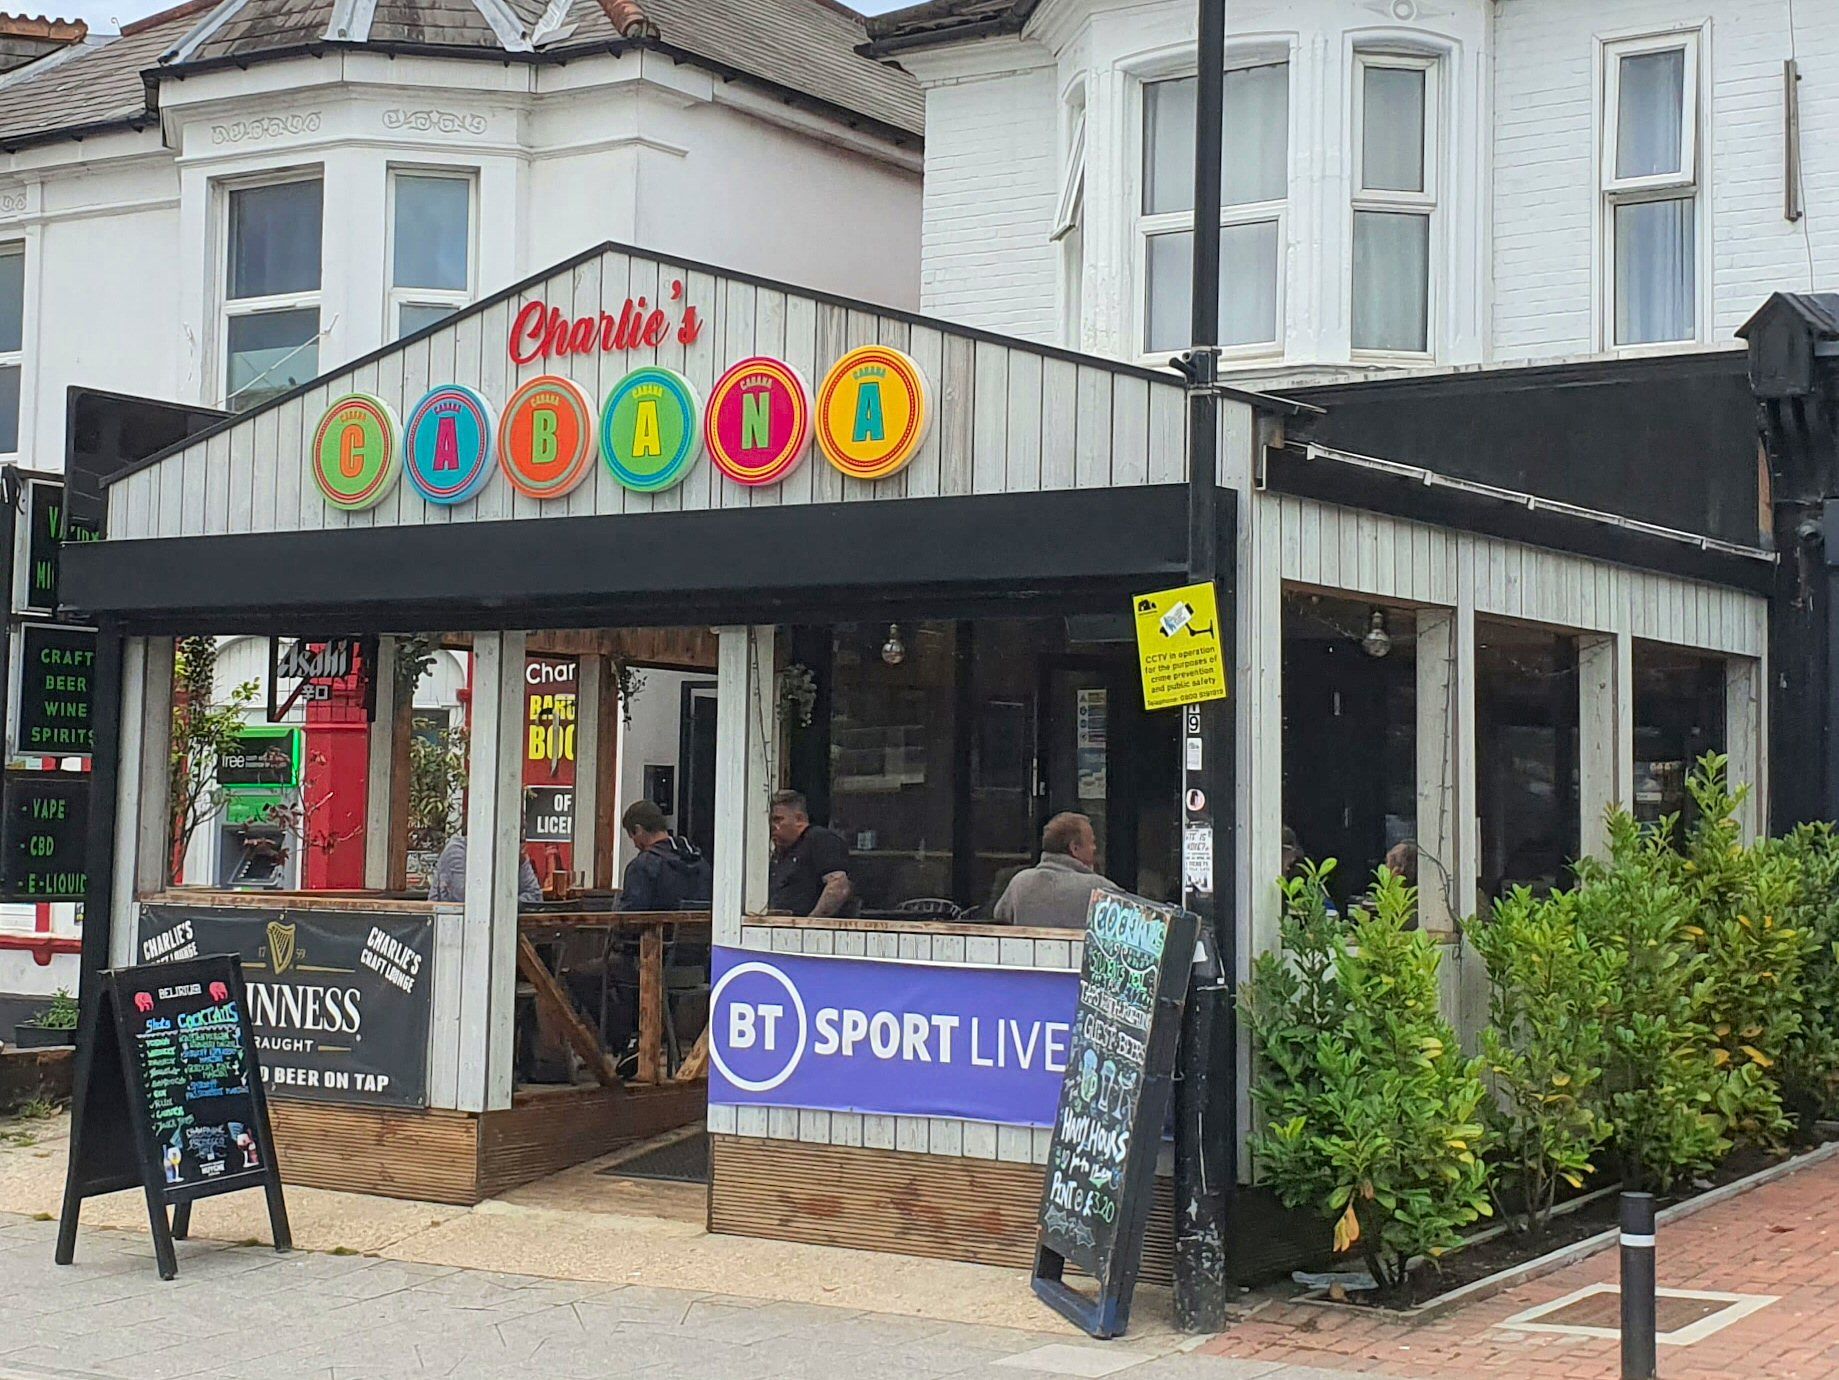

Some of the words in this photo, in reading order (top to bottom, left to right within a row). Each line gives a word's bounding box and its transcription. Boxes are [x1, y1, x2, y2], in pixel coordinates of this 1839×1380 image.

[509, 280, 704, 365] Charlie's
[41, 649, 94, 667] CRAFT
[277, 640, 348, 678] Asahi
[1145, 653, 1168, 664] CCTV
[1169, 651, 1176, 660] in
[1178, 646, 1215, 660] operation
[1145, 665, 1156, 674] for
[1158, 663, 1170, 672] the
[1172, 658, 1207, 672] purposes
[1209, 654, 1217, 664] of
[525, 662, 576, 684] Char
[1151, 674, 1171, 683] crime
[1173, 667, 1214, 681] prevention
[45, 675, 87, 692] BEER
[302, 685, 328, 701] 辛口
[1151, 684, 1165, 694] and
[1167, 680, 1190, 692] public
[1192, 676, 1216, 687] safety
[44, 701, 87, 718] WINE
[33, 798, 66, 819] VAPE
[30, 836, 55, 856] CBD
[143, 920, 193, 961] CHARLIE'S
[366, 926, 423, 975] CHARLIE'S
[360, 948, 388, 975] CRAFT
[384, 963, 416, 994] LOUNGE
[728, 1002, 784, 1051] BT
[814, 1007, 960, 1064] SPORT
[970, 1017, 1070, 1073] LIVE
[274, 1066, 320, 1087] BEER
[324, 1070, 352, 1090] ON
[354, 1072, 390, 1093] TAP
